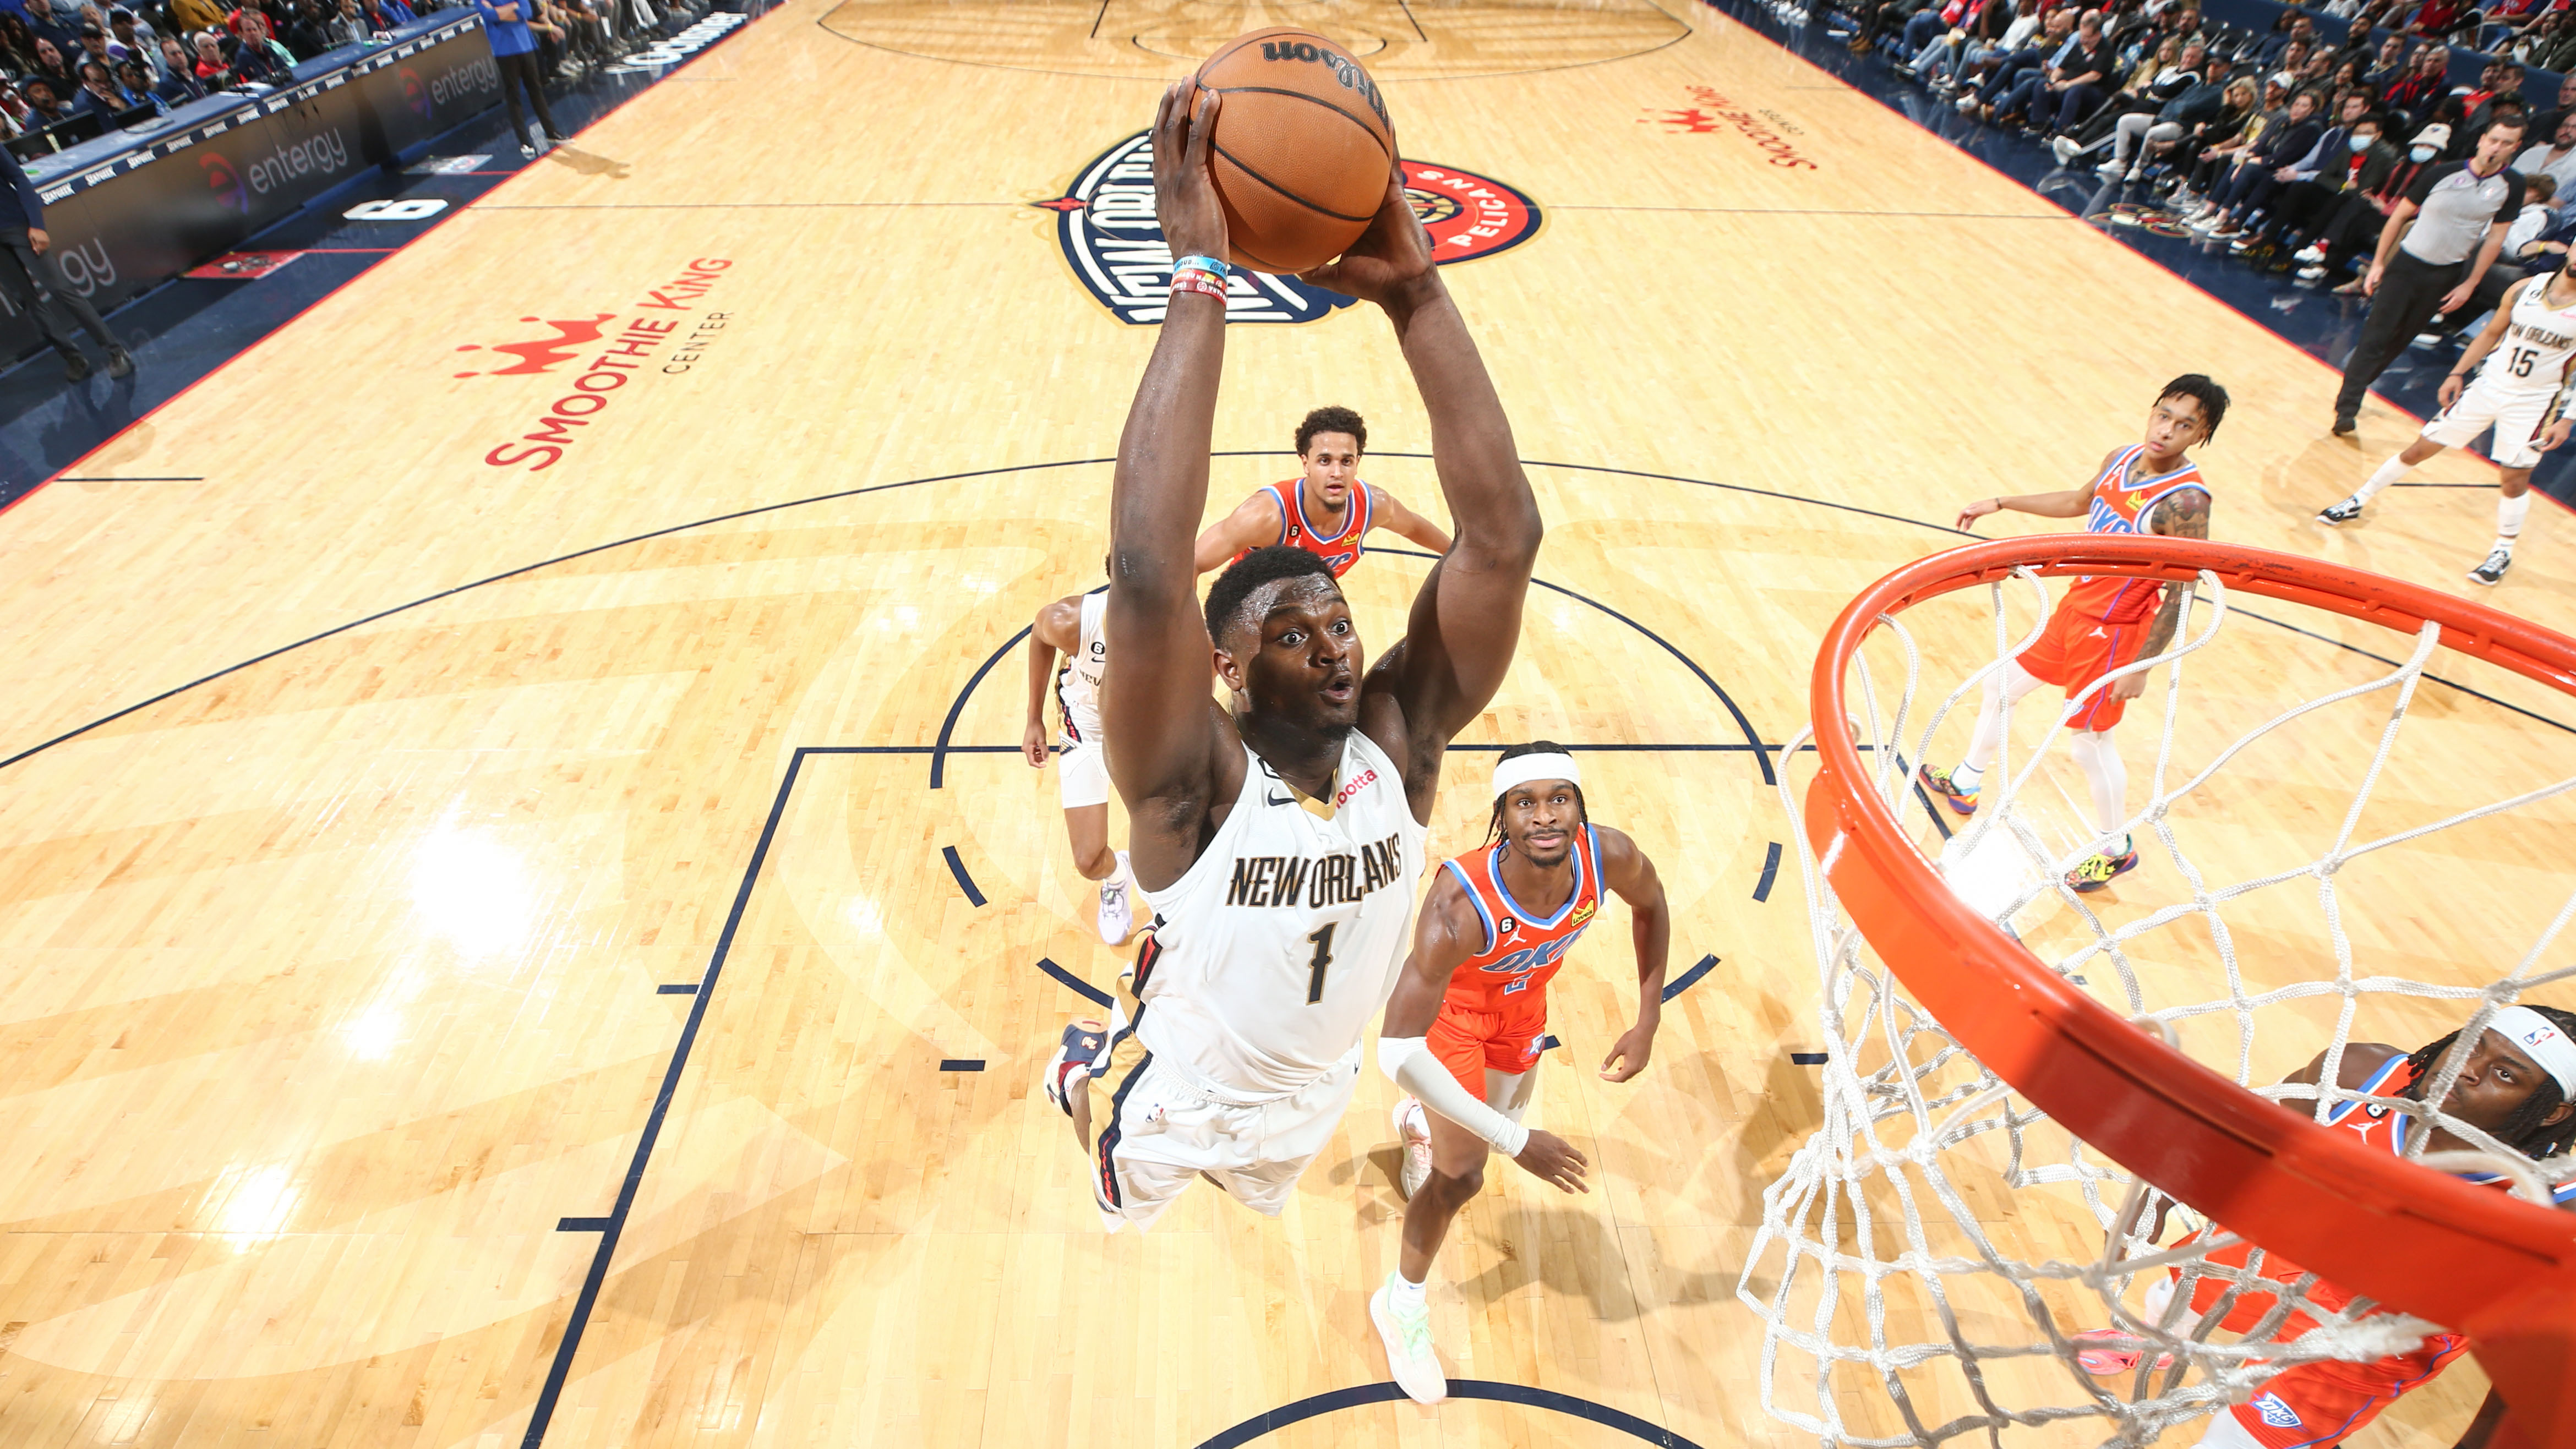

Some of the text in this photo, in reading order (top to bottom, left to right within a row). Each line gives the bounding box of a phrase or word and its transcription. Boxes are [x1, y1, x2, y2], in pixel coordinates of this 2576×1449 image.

[431, 54, 498, 105] entergy
[248, 127, 348, 194] entergy
[342, 199, 449, 220] 6
[1416, 169, 1509, 248] PELICANS
[662, 311, 735, 374] CENTER
[2507, 346, 2540, 378] 15
[485, 318, 679, 472] SMOOTHIE
[1291, 525, 1298, 537] 6
[1093, 643, 1103, 653] 6
[1225, 832, 1401, 910] NEW ORLANS
[1501, 918, 1513, 933] 6
[1305, 920, 1339, 1006] 1
